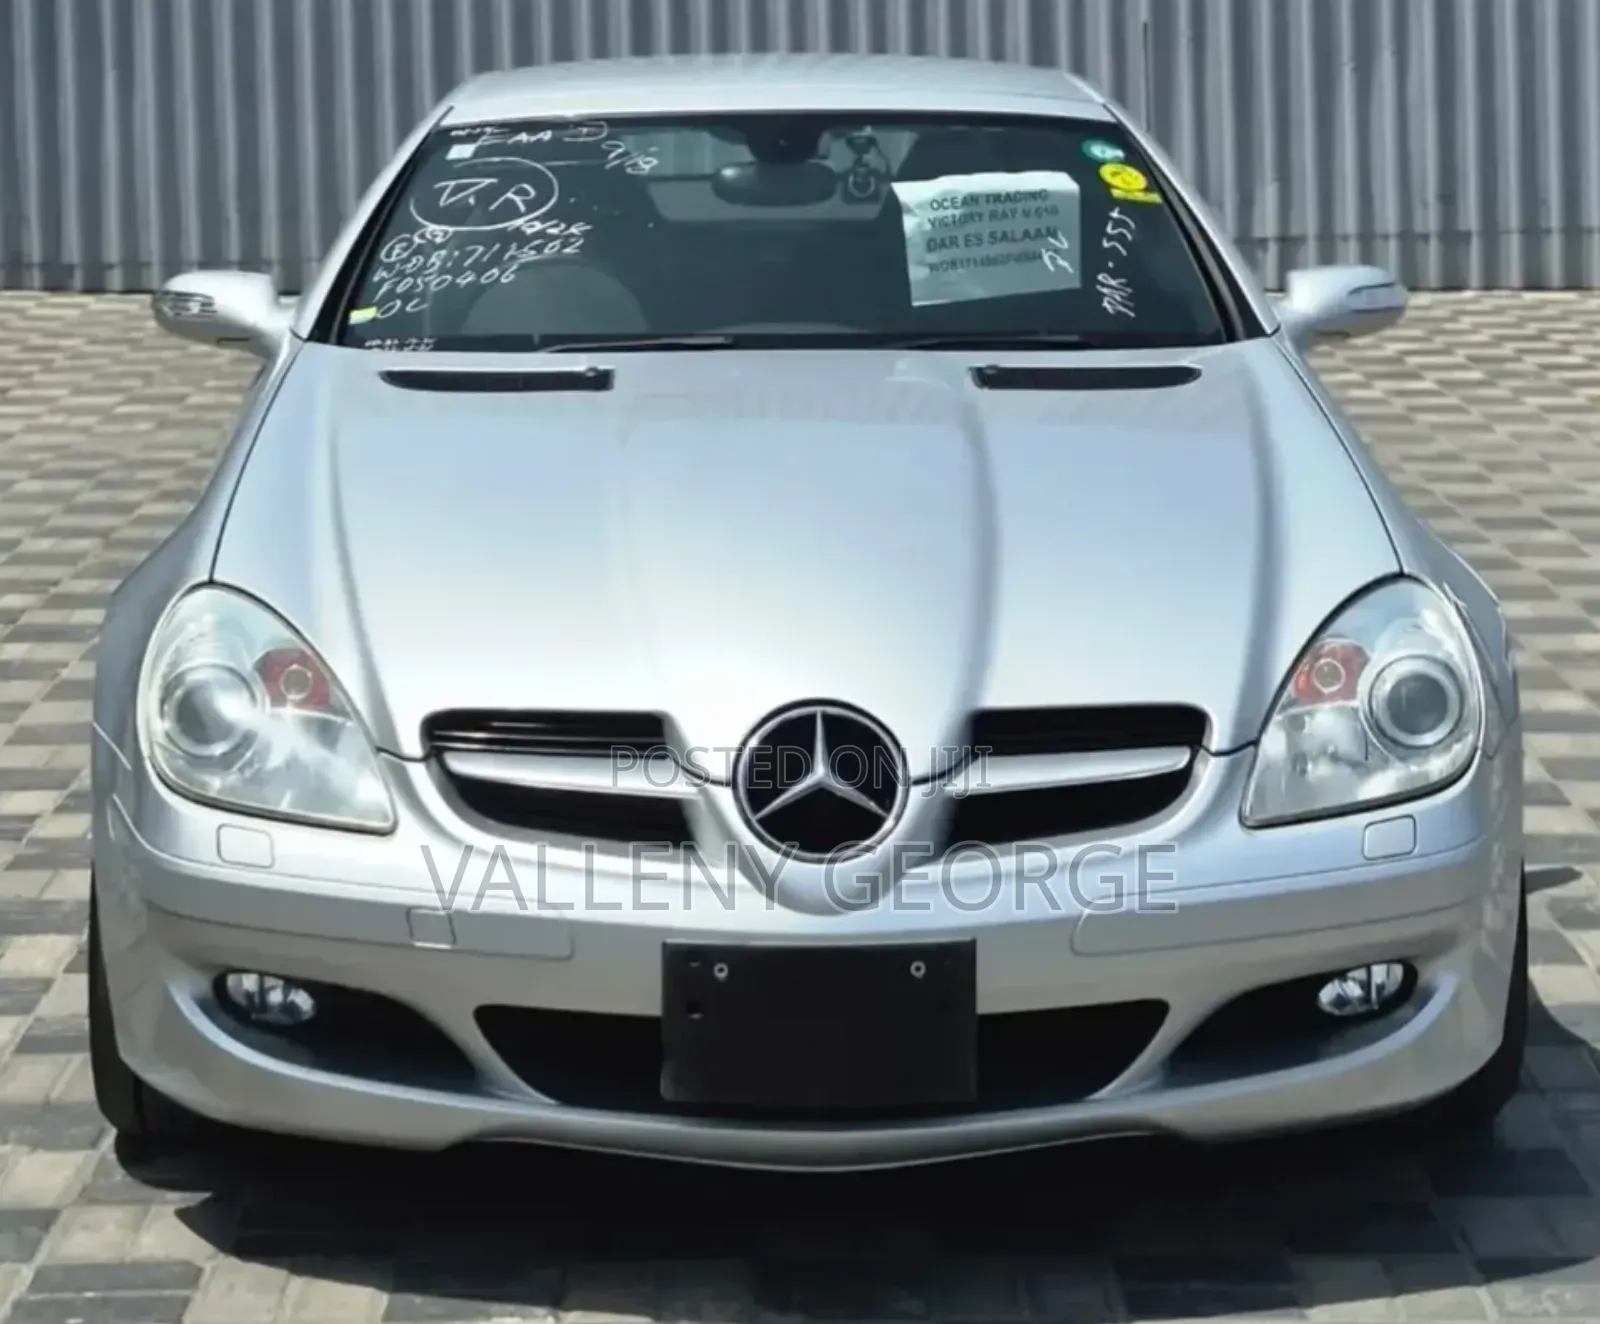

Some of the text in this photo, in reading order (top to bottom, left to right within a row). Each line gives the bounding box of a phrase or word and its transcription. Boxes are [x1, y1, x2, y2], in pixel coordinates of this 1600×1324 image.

[930, 188, 1049, 212] OCEAN TRADING
[927, 211, 983, 229] VICTORY
[926, 234, 960, 253] DAR
[964, 232, 984, 248] ES
